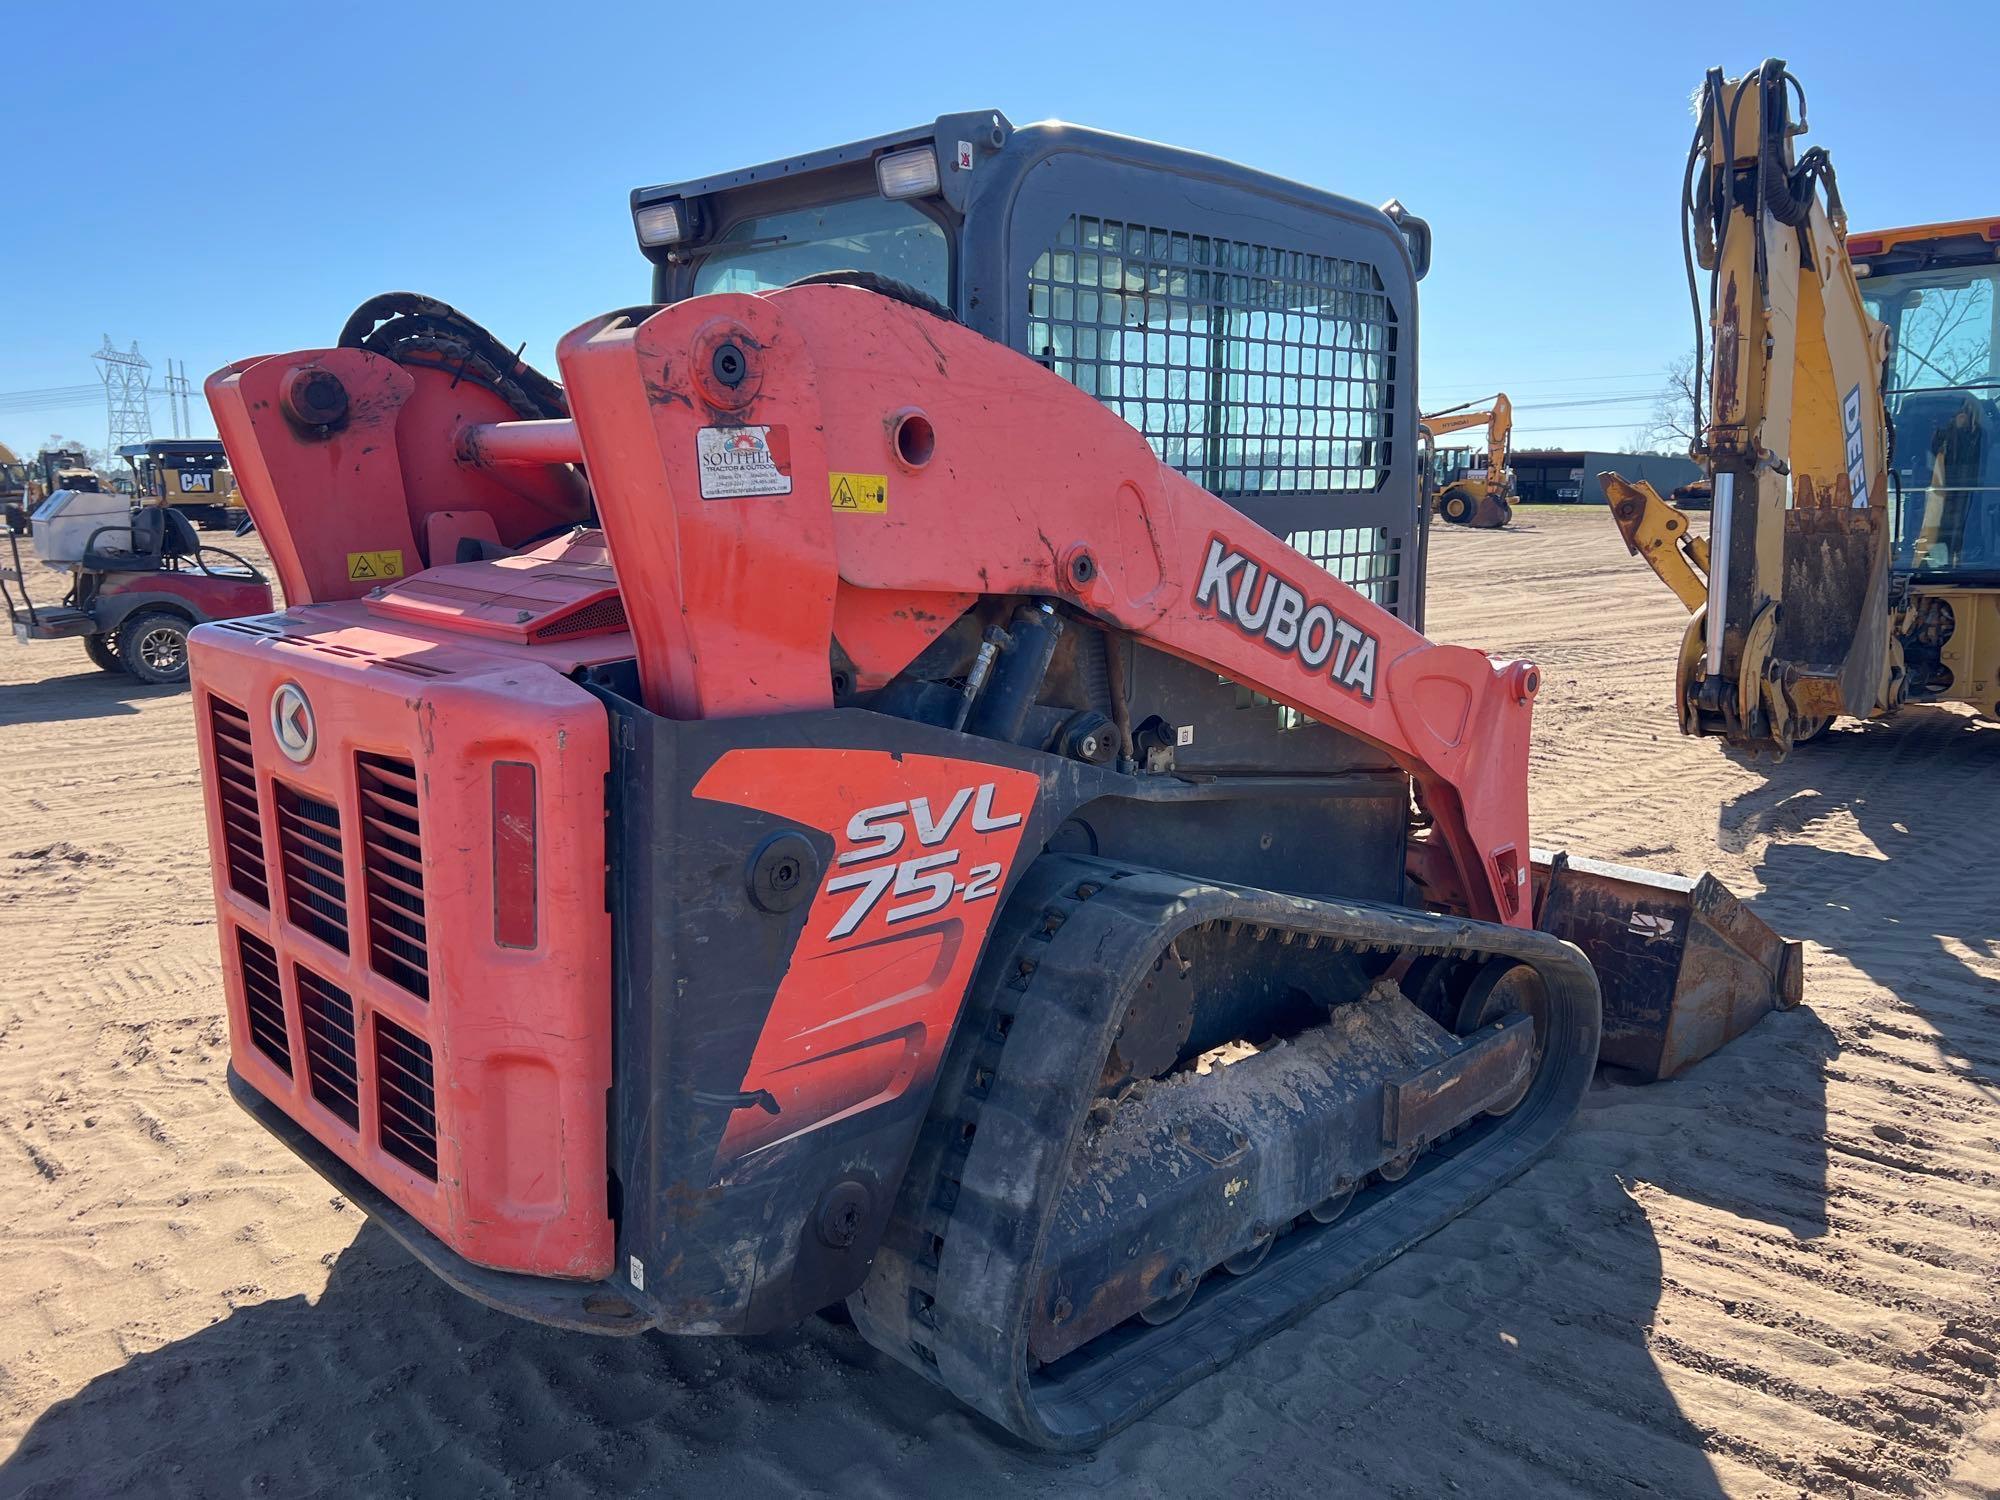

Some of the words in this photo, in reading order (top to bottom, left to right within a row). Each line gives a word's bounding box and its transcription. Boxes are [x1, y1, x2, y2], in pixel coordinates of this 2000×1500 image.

[1442, 419, 1469, 428] HYUNDAI
[181, 473, 211, 491] CAT
[1195, 540, 1376, 698] KUBOTA
[838, 783, 1021, 866] SVL
[826, 849, 1001, 941] 75-2
